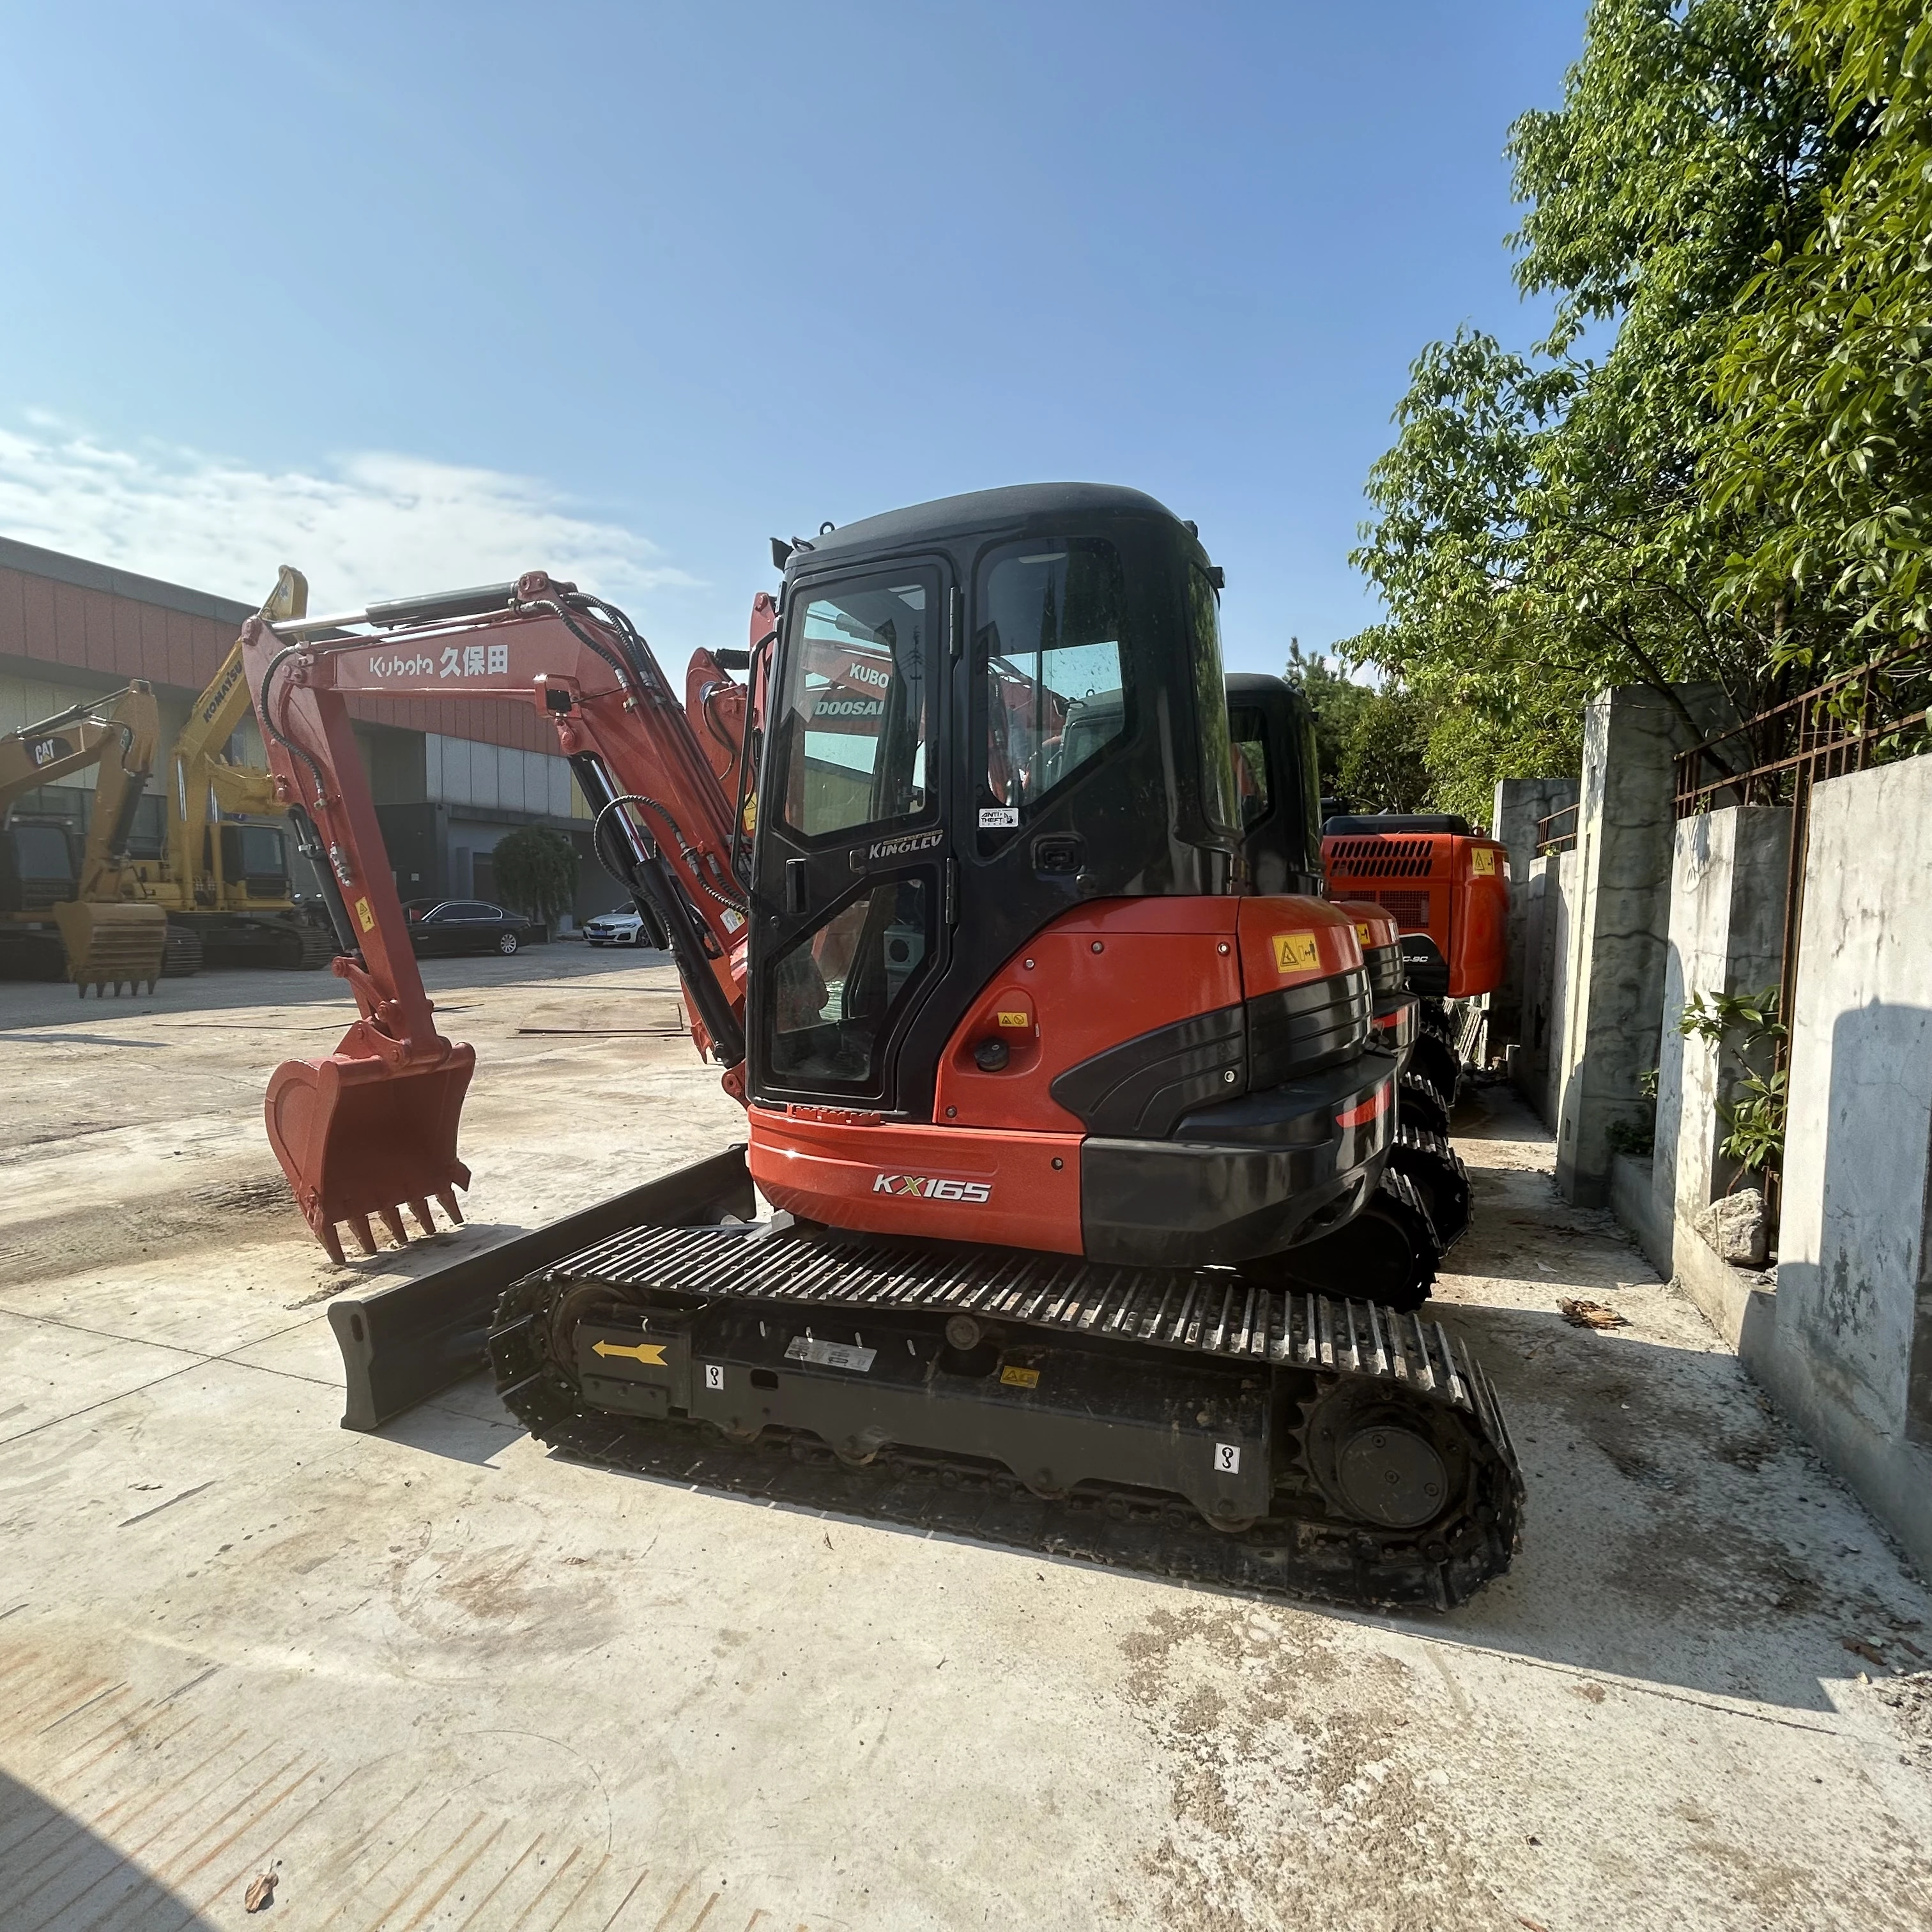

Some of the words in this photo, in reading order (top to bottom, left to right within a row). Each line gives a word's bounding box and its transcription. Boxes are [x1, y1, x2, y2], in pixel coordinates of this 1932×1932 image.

[370, 654, 433, 678] Kubota
[440, 645, 509, 678] 久保田
[203, 660, 242, 723] KOMATSU
[35, 739, 55, 764] CAT
[873, 1174, 992, 1203] KX165
